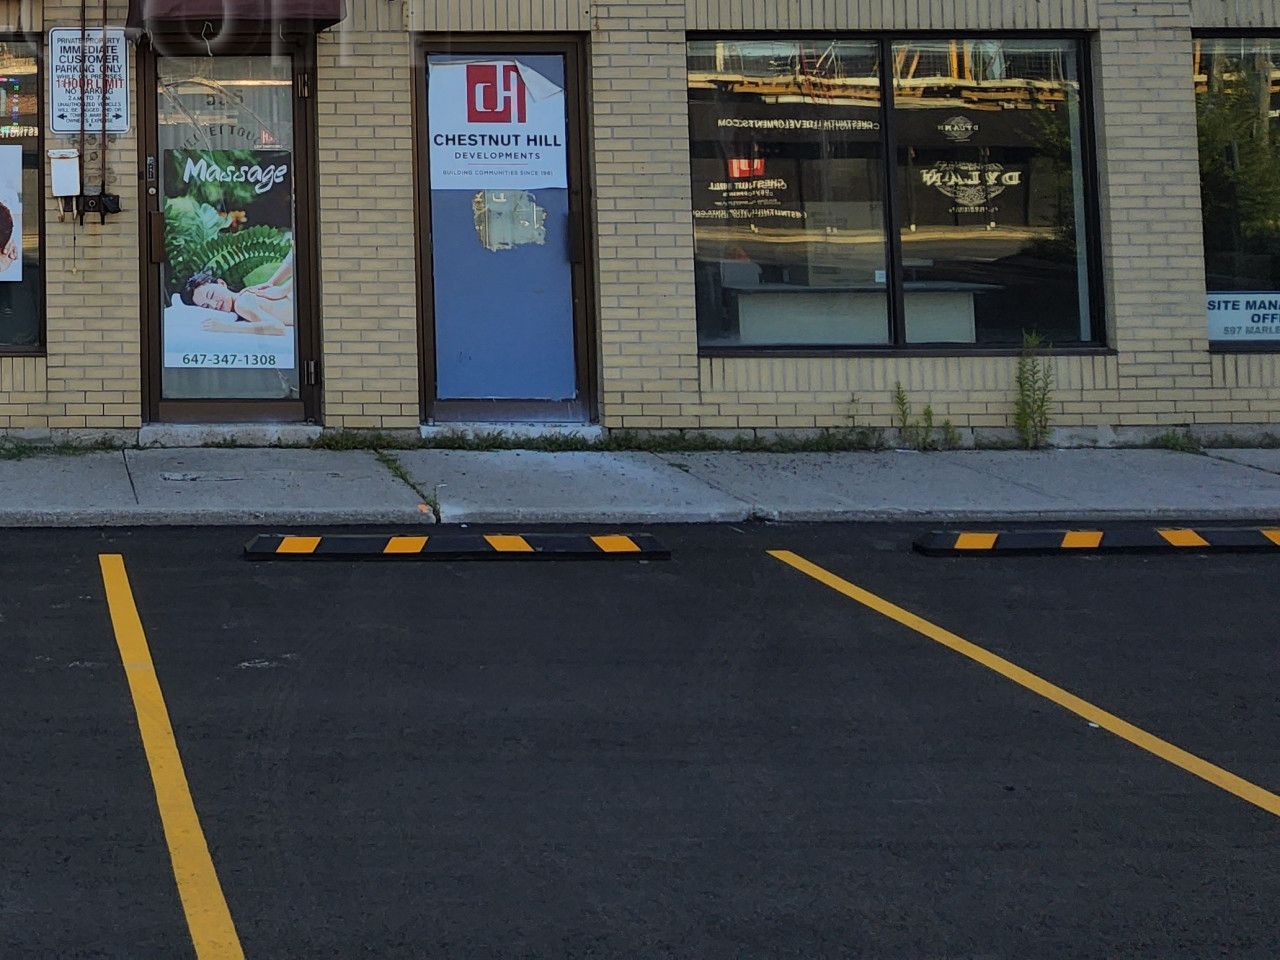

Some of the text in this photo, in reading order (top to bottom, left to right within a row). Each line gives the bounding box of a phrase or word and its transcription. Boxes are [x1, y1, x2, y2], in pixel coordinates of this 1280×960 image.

[60, 46, 118, 54] IMMEDIATE
[59, 55, 119, 64] CUSTOMER
[56, 65, 95, 73] PARKING
[96, 79, 124, 88] LMIT
[433, 134, 562, 147] CHESTNUT HILL
[183, 157, 288, 194] Massage
[1207, 300, 1280, 311] SITE MAN
[1223, 327, 1242, 335] 597
[182, 353, 276, 366] 647-347-1308
